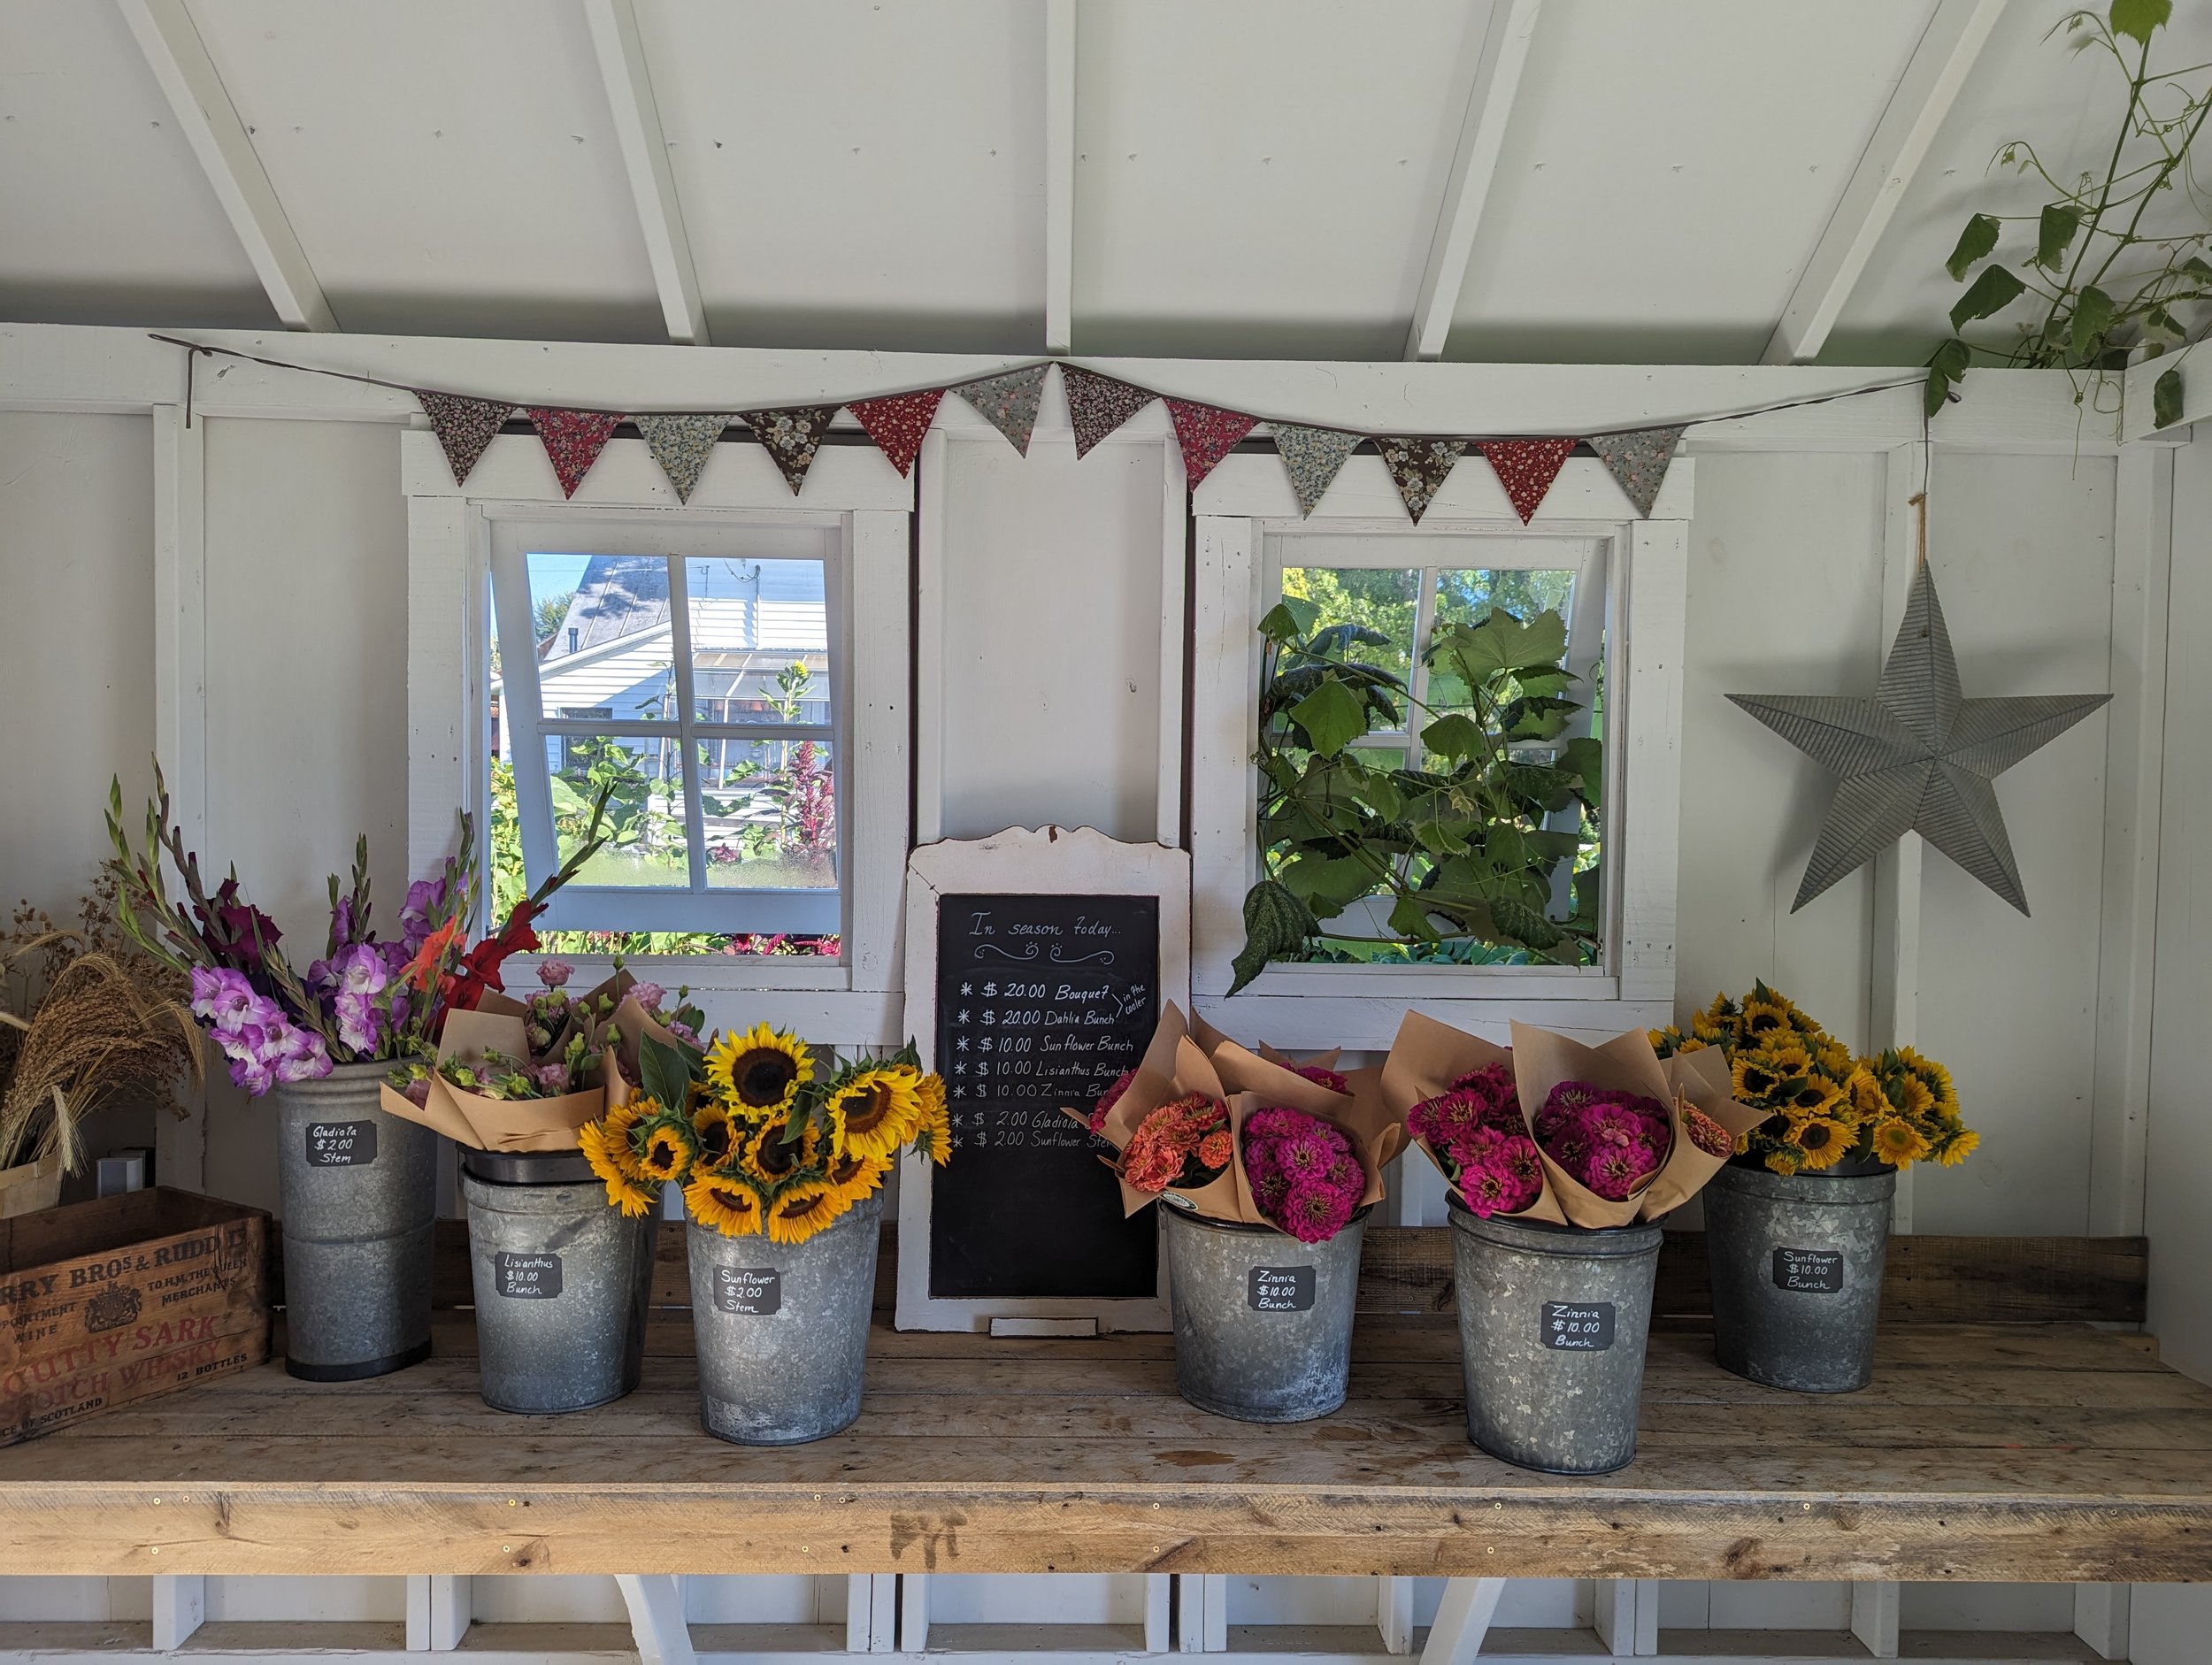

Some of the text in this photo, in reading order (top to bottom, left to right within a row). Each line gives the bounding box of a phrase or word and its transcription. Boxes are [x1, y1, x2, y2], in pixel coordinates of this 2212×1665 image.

[969, 911, 995, 935] In
[1008, 923, 1064, 936] season
[1055, 984, 1110, 1004] Bouquet
[1131, 983, 1146, 998] the
[1125, 996, 1147, 1015] cooler
[1044, 1010, 1079, 1026] Dahlia
[1084, 1010, 1115, 1025] Bunch
[1097, 1035, 1133, 1053] Bunch
[1035, 1061, 1090, 1077] Lisianthus
[1041, 1083, 1080, 1097] Zinnia
[1032, 1110, 1079, 1129] Gladiola
[313, 1125, 357, 1138] Gladiola
[1030, 1130, 1081, 1147] Sunflower
[319, 1153, 351, 1163] Stem
[135, 1255, 150, 1272] &
[504, 1255, 553, 1268] Lisianthus
[1783, 1251, 1838, 1263] Sunflower
[148, 1277, 162, 1292] TO
[189, 1266, 210, 1282] THE
[211, 1258, 247, 1279] QUEEN
[505, 1270, 538, 1281] $10.00
[721, 1270, 775, 1284] Sunflower
[1257, 1270, 1296, 1283] Zinnia
[1787, 1276, 1831, 1289] Bunch
[161, 1277, 236, 1308] MERCHANTS
[507, 1282, 542, 1294] Bunch
[724, 1285, 762, 1299] $2.00
[1256, 1285, 1295, 1296] $10.00
[725, 1300, 759, 1313] Stem
[1258, 1298, 1296, 1308] Bunch
[1552, 1305, 1600, 1319] Zinnia
[13, 1324, 58, 1344] WINE
[1555, 1334, 1594, 1347] Bunch
[4, 1316, 220, 1397] CUTTY SARK
[119, 1340, 221, 1385] WHISKY
[177, 1353, 248, 1382] 12 BOTTLES
[22, 1417, 36, 1431] OF
[41, 1397, 103, 1424] SCOTLAND
